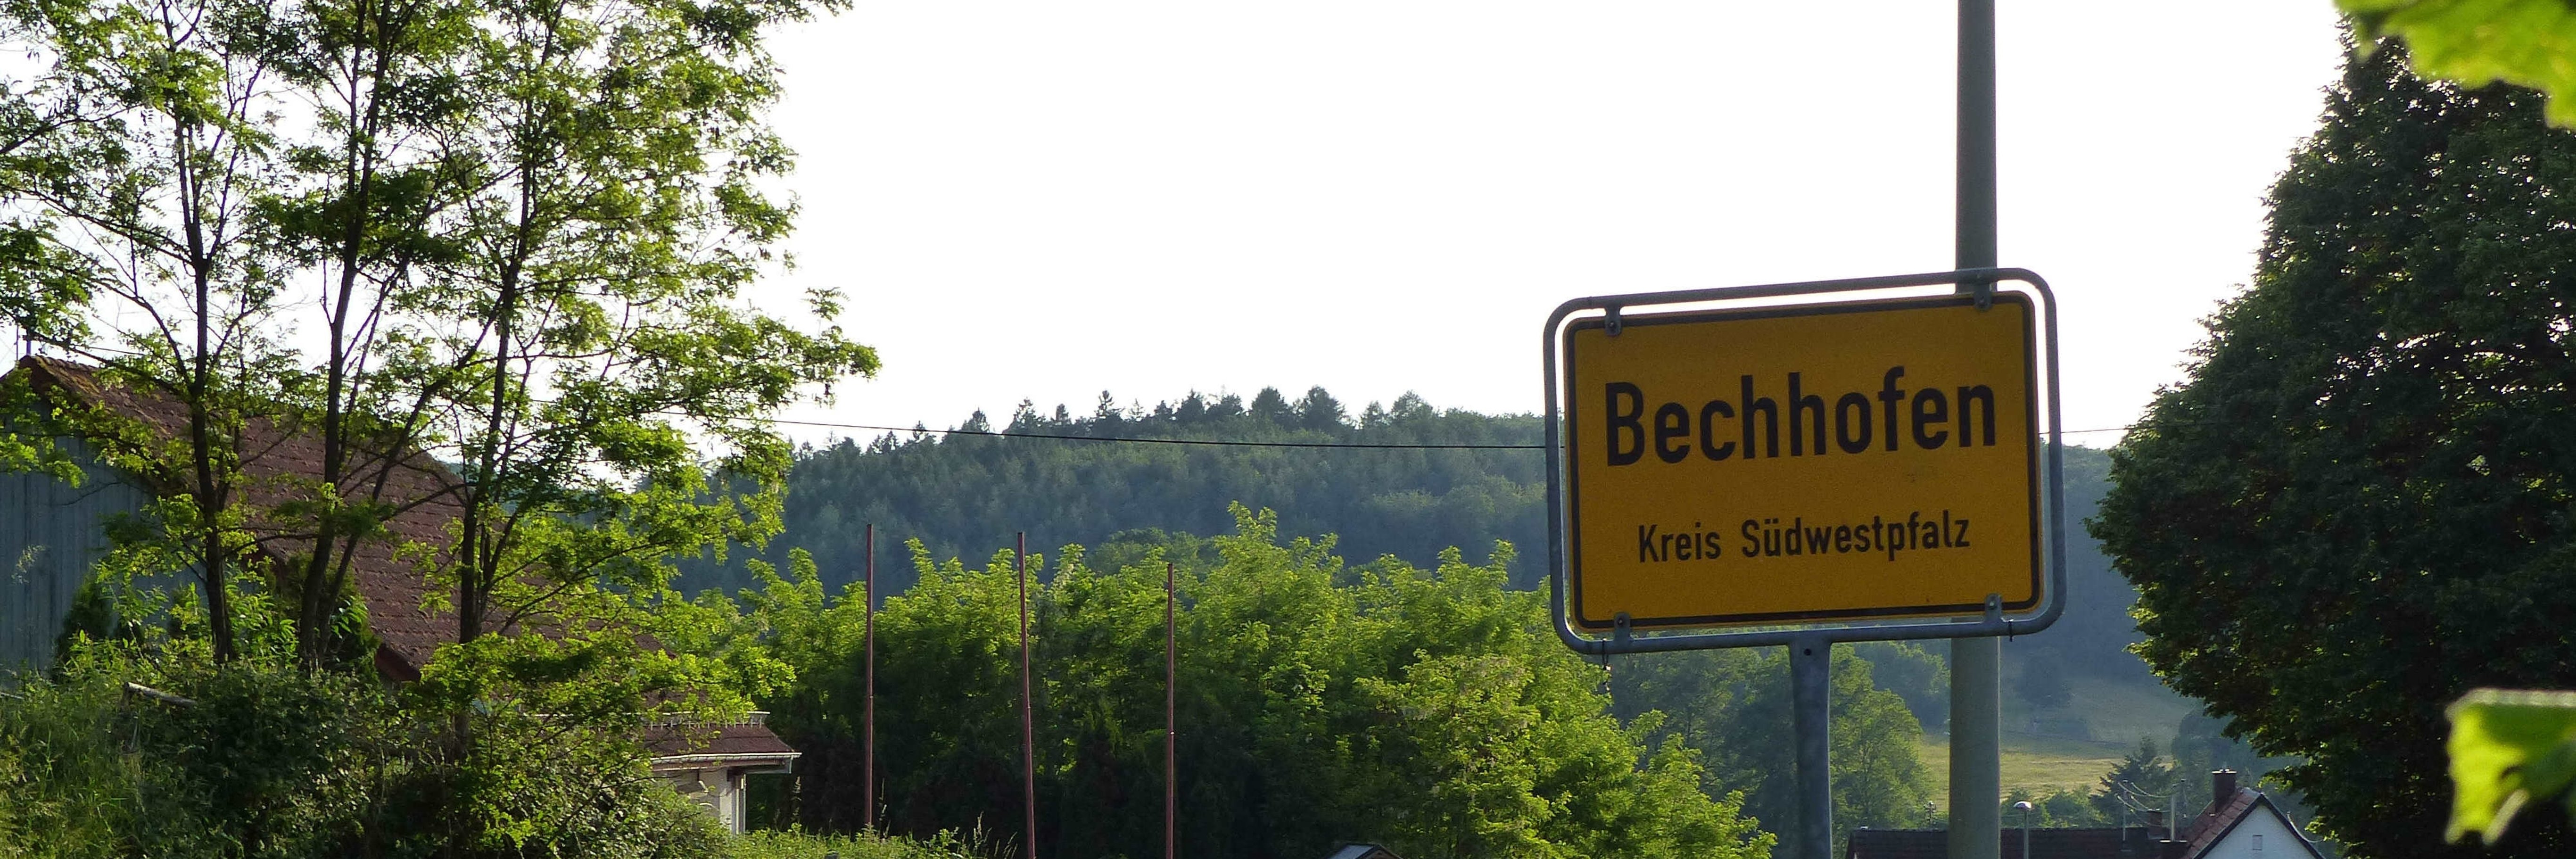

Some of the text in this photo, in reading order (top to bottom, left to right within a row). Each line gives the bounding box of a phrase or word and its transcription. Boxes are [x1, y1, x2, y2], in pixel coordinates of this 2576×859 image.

[1605, 366, 1996, 466] Bechhofen
[1639, 510, 1970, 563] Kreis Südwestpfalz
